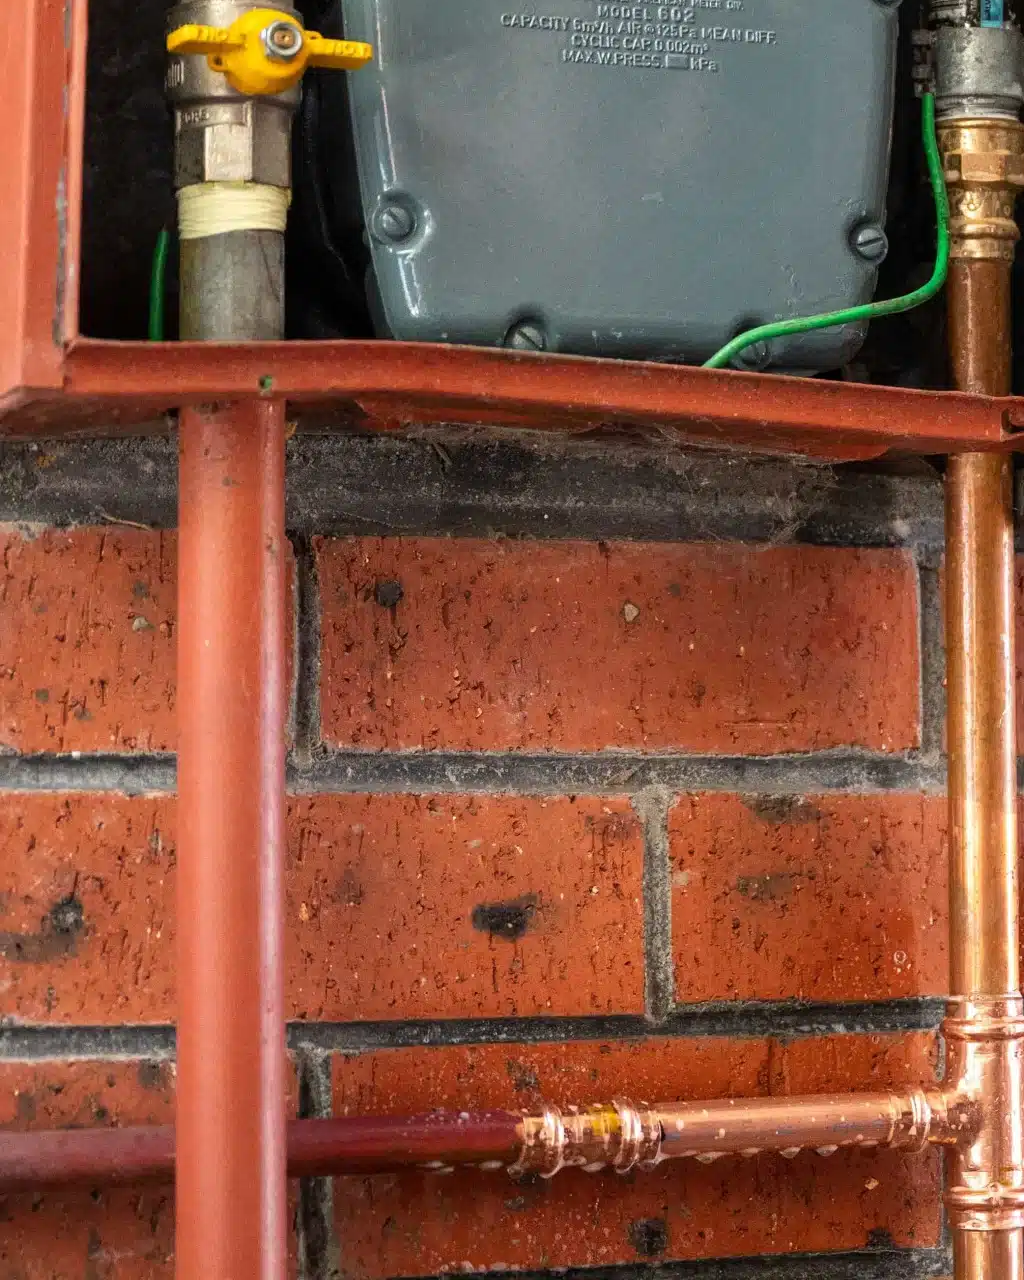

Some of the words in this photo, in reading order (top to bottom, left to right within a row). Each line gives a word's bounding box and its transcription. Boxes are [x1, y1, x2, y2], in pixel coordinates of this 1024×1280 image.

[597, 4, 651, 20] MODEL
[657, 6, 695, 24] 602
[726, 0, 744, 11] DIV.
[500, 13, 570, 31] CAPACITY
[617, 21, 641, 36] AIR
[701, 26, 741, 41] MEAN
[745, 28, 777, 45] DIFF.
[571, 33, 620, 50] CYCLIC
[622, 36, 651, 52] CAP.
[690, 56, 718, 71] kPa
